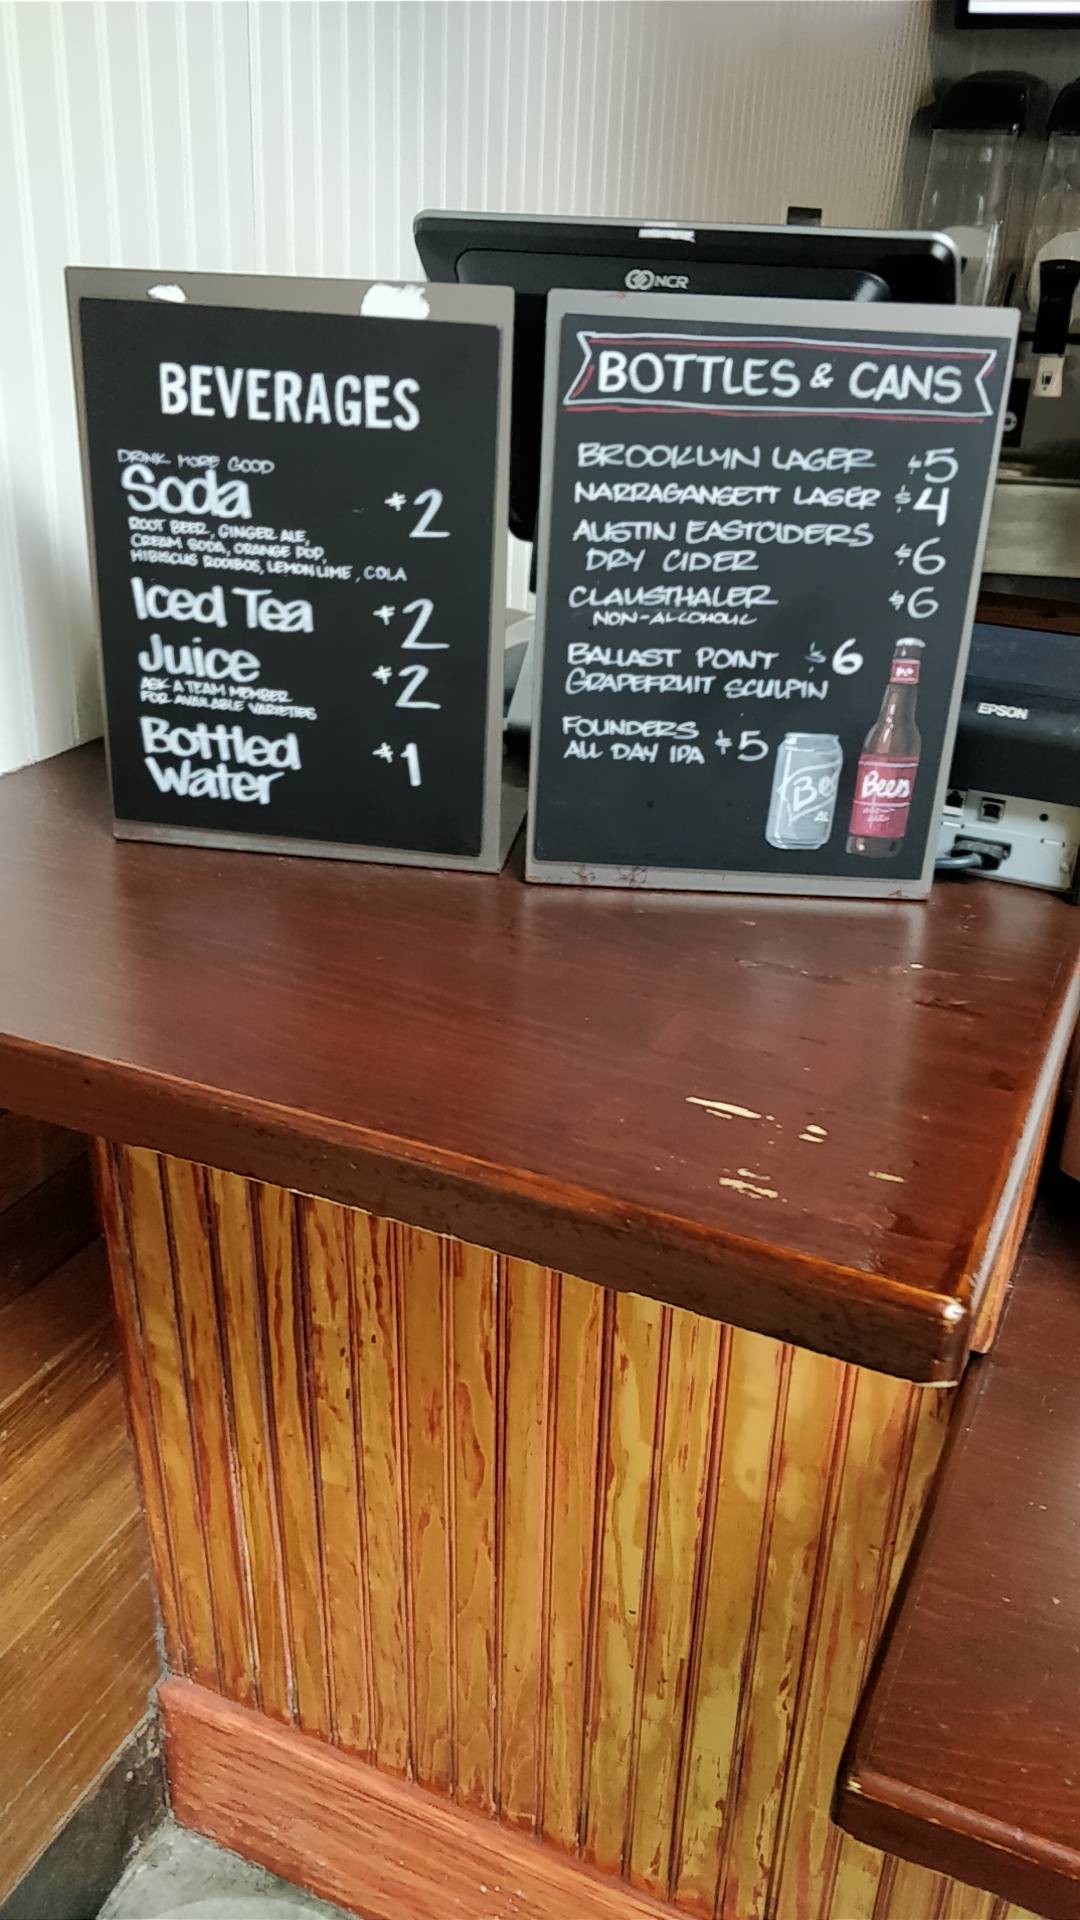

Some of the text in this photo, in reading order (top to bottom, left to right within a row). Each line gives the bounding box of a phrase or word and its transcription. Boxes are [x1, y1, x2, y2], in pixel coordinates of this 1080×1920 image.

[654, 275, 689, 289] NCR
[599, 351, 963, 404] BOTTLES & CANS
[159, 362, 421, 431] BEVERAGES
[117, 449, 171, 465] DRINK
[227, 456, 275, 474] GOOD
[577, 442, 760, 469] BROOKLYN
[771, 446, 878, 473] LAGER
[121, 463, 252, 519] Soda
[574, 481, 950, 527] NARRAGANSETT LAGER $4
[128, 516, 166, 532] ROOT
[218, 524, 278, 540] GINGER
[573, 519, 874, 547] AUSTIN EASTCIDERS
[130, 533, 183, 549] CREAM
[233, 542, 291, 558] ORANGE
[585, 537, 947, 576] DRY CIDER $6
[130, 549, 199, 567] HIBISCUS
[363, 565, 408, 582] COLA
[130, 576, 228, 628] Iced
[231, 587, 314, 633] Tea
[568, 585, 939, 619] CLAUSTHALER $6
[593, 611, 757, 626] NON-ALCOHOLIC
[138, 633, 261, 683] Juice
[567, 642, 682, 668] BALLAST
[695, 646, 779, 670] POINT
[804, 637, 864, 675] $6
[140, 676, 293, 703] ASK A TEAM MEMBER
[565, 667, 829, 700] GRAPEFRUIT SCULPIN
[140, 690, 172, 704] FOR
[248, 703, 318, 720] VARIETIES
[977, 702, 1029, 720] EPSON
[140, 715, 302, 770] Bottled
[562, 715, 700, 740] FOUNDERS
[563, 730, 769, 765] ALL DAY IPA $5
[144, 756, 285, 805] Water
